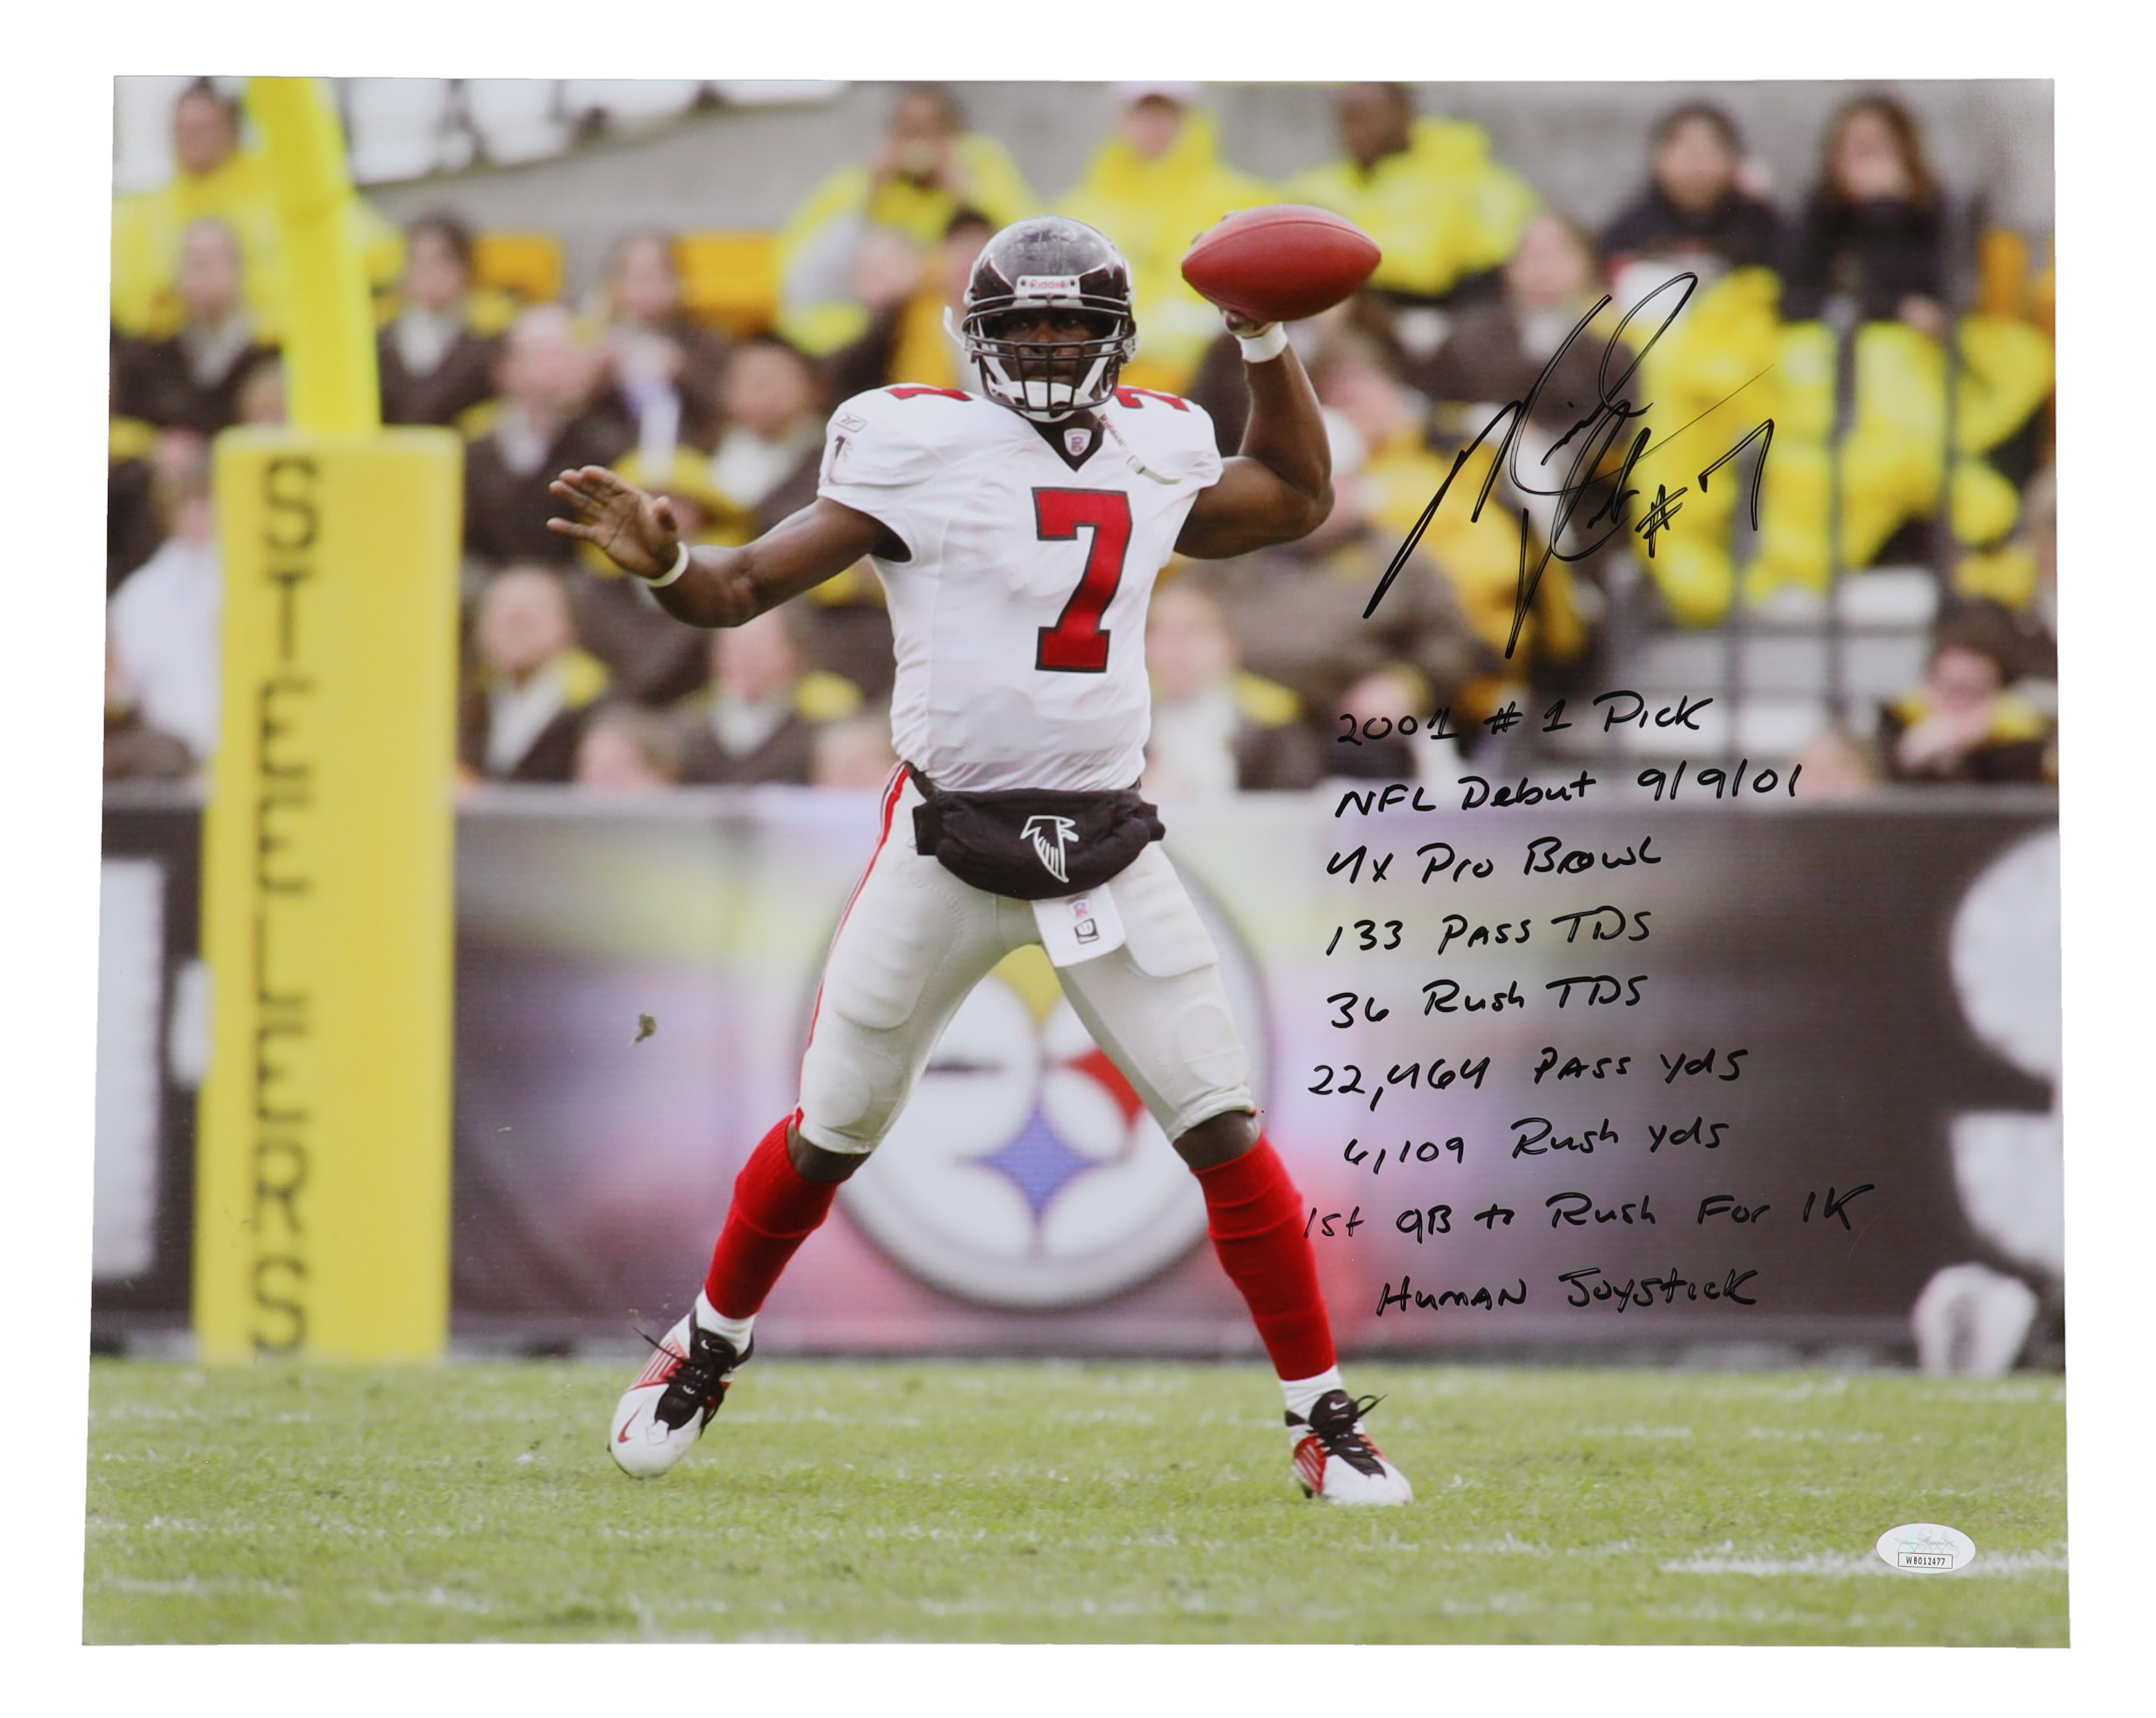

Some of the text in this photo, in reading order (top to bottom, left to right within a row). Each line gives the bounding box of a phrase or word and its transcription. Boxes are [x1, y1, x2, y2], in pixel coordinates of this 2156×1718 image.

[1029, 486, 1133, 673] 7
[1337, 707, 1459, 746] 2001
[1335, 759, 1802, 818] NFL Debut 9/9/01
[1417, 843, 1494, 884] Pro
[250, 456, 321, 1356] STEELERS
[1326, 920, 1403, 956] 133
[1327, 993, 1389, 1028] 36
[1422, 979, 1525, 1015] Rush
[1308, 1057, 1491, 1111] 22,464
[1510, 1117, 1619, 1159] Rush
[1303, 1206, 1365, 1238] 1st
[1546, 1192, 1656, 1228] Rush
[1697, 1195, 1771, 1225] For
